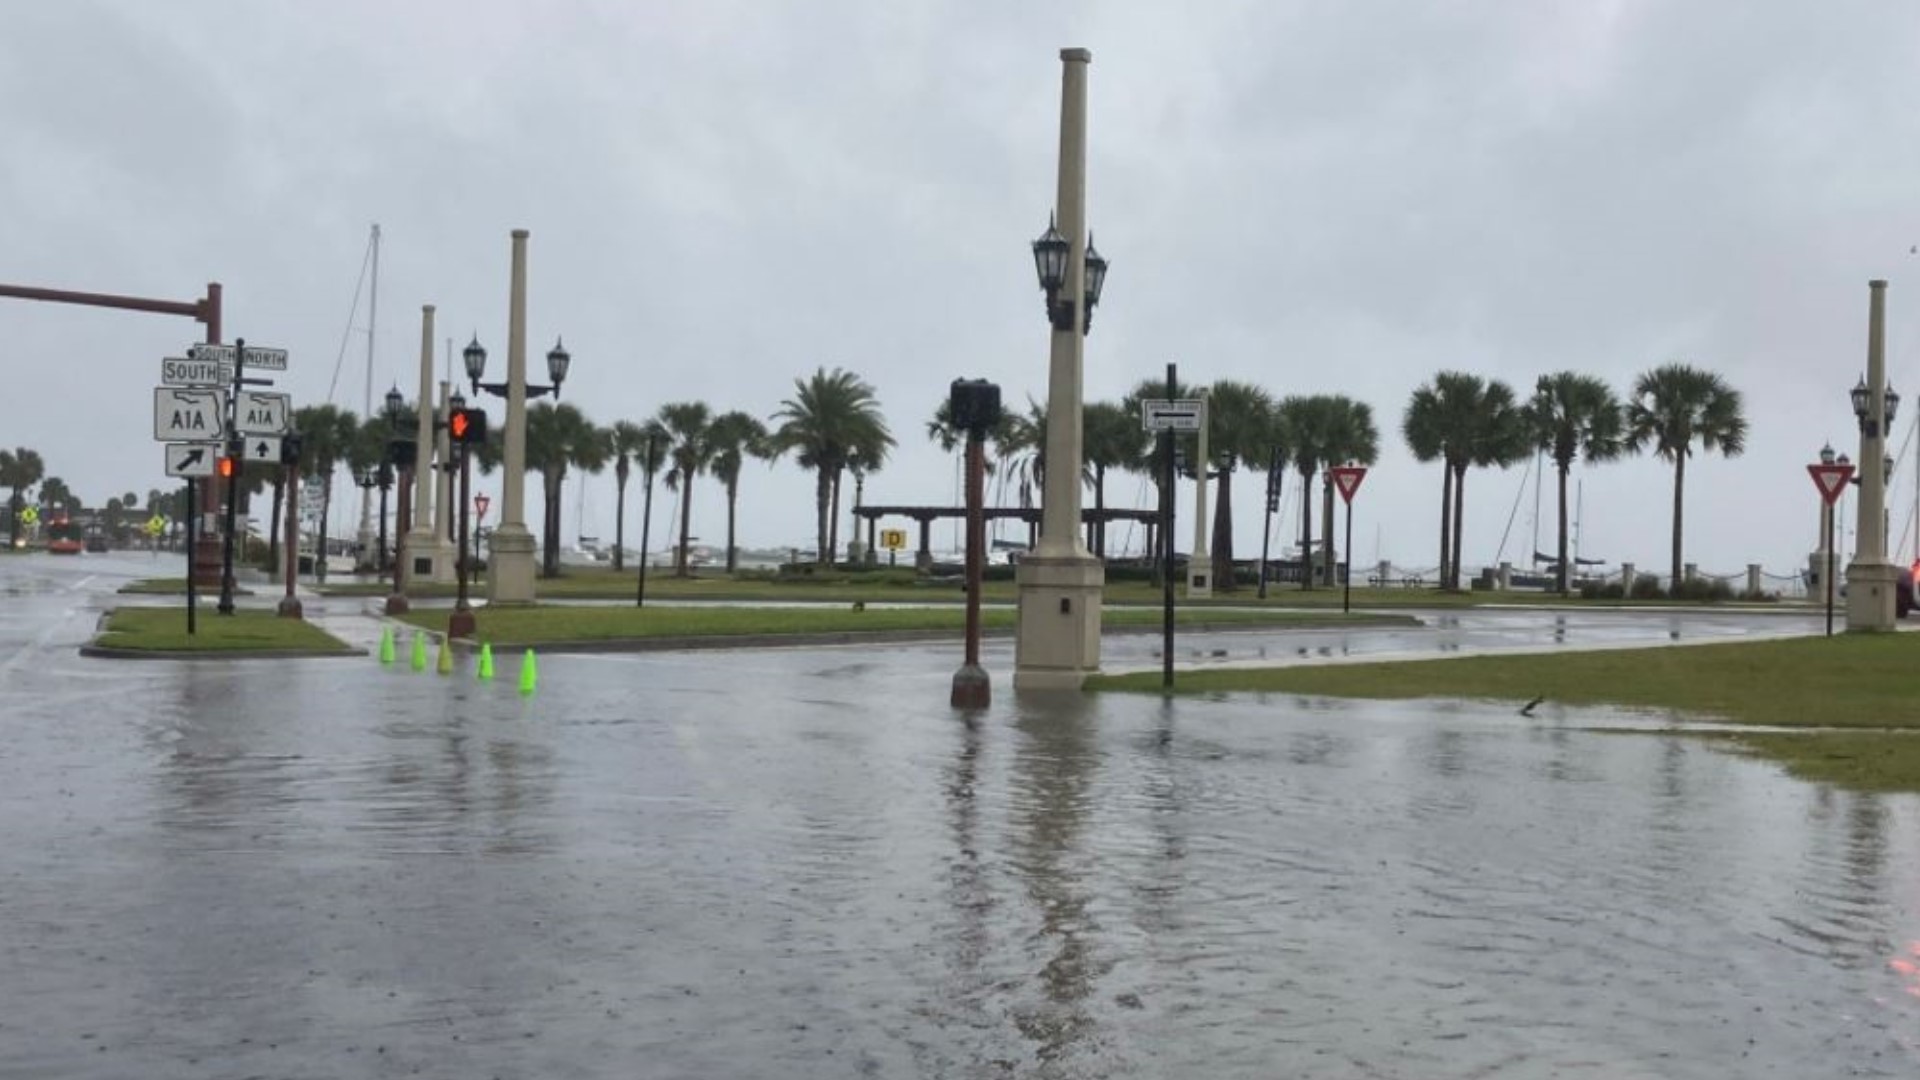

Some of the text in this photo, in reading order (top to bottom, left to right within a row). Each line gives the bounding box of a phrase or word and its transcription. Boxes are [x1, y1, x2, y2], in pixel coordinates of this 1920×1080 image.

[198, 346, 235, 360] SOUTH
[245, 350, 285, 364] NORTH
[166, 362, 216, 380] SOUTH
[170, 409, 205, 430] A1A
[247, 409, 272, 424] A1A
[889, 531, 900, 545] D
